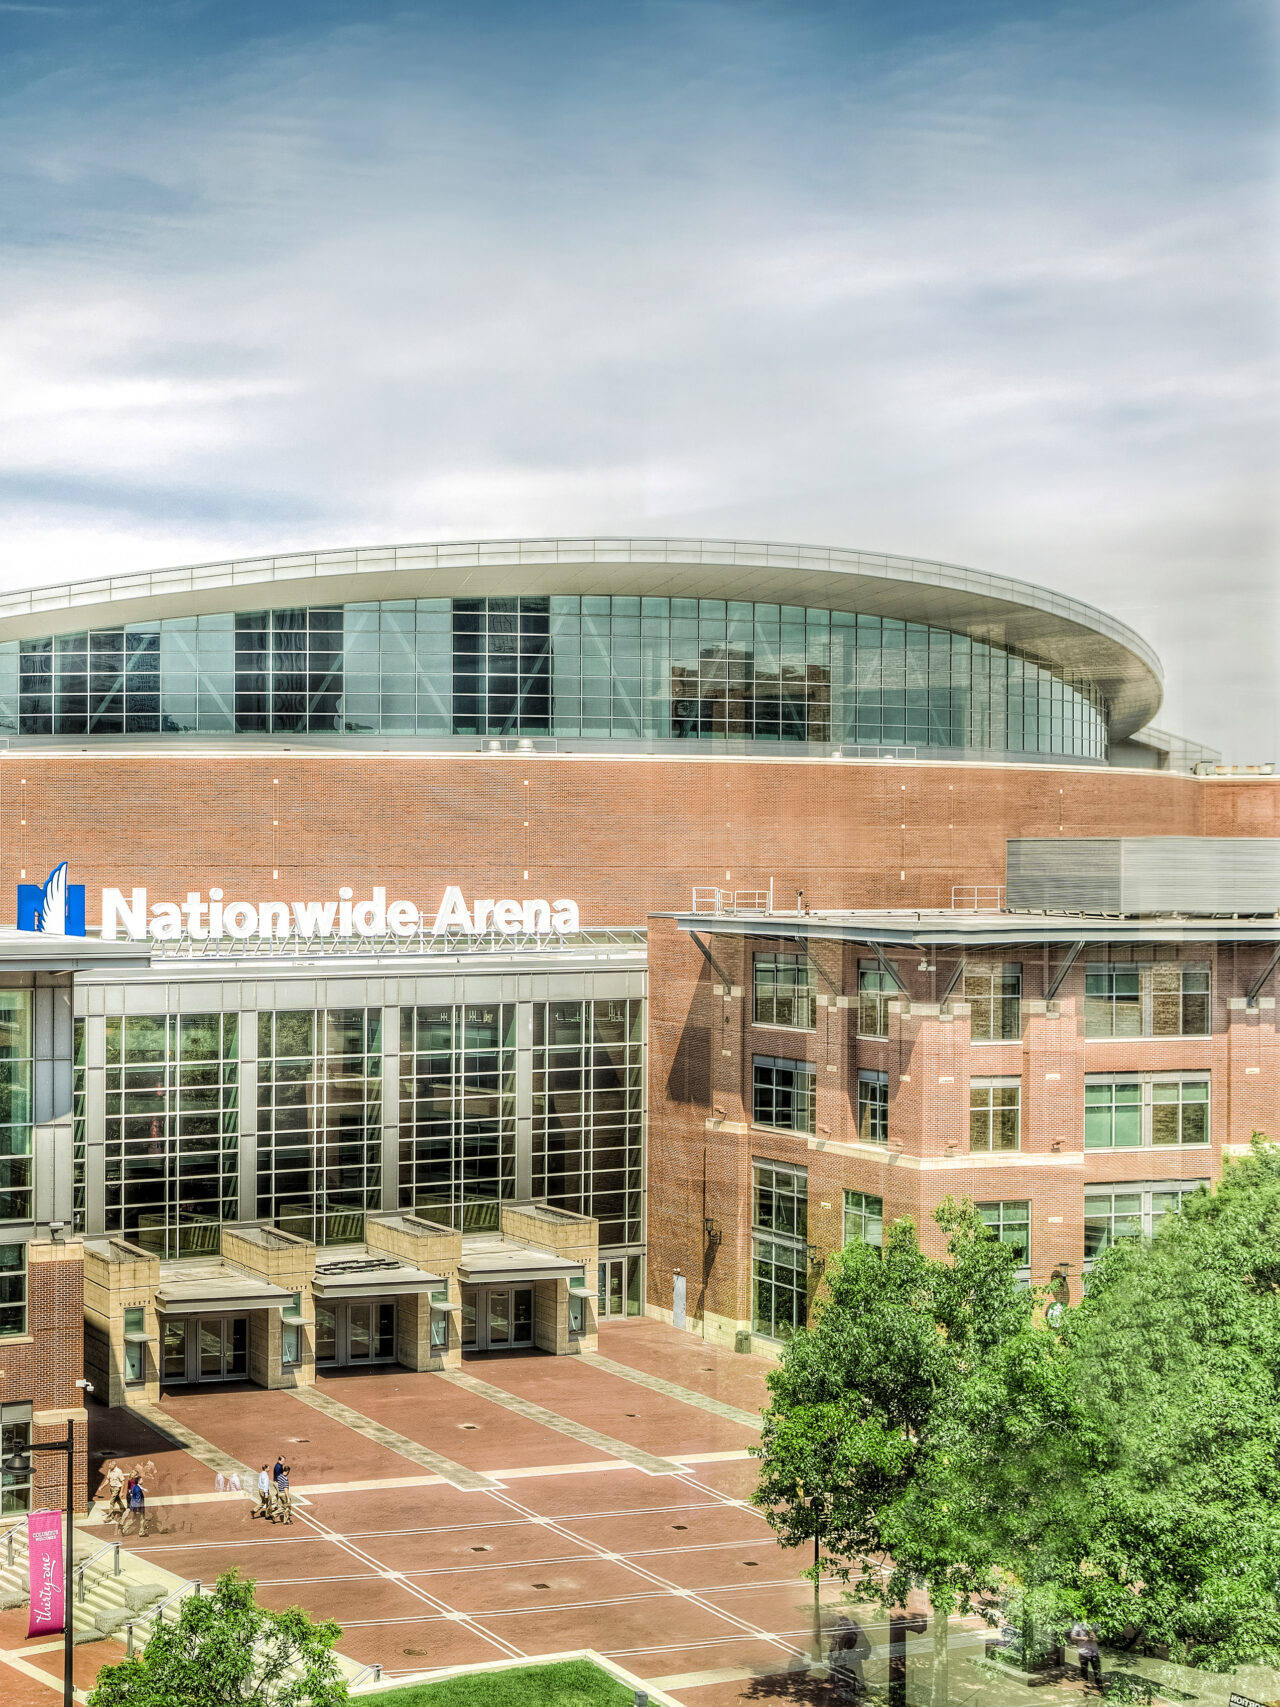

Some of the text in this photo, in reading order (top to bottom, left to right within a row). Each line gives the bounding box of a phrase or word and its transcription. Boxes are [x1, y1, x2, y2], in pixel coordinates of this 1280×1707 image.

[102, 886, 579, 940] Nationwide Arena
[33, 1552, 62, 1623] thirty-one
